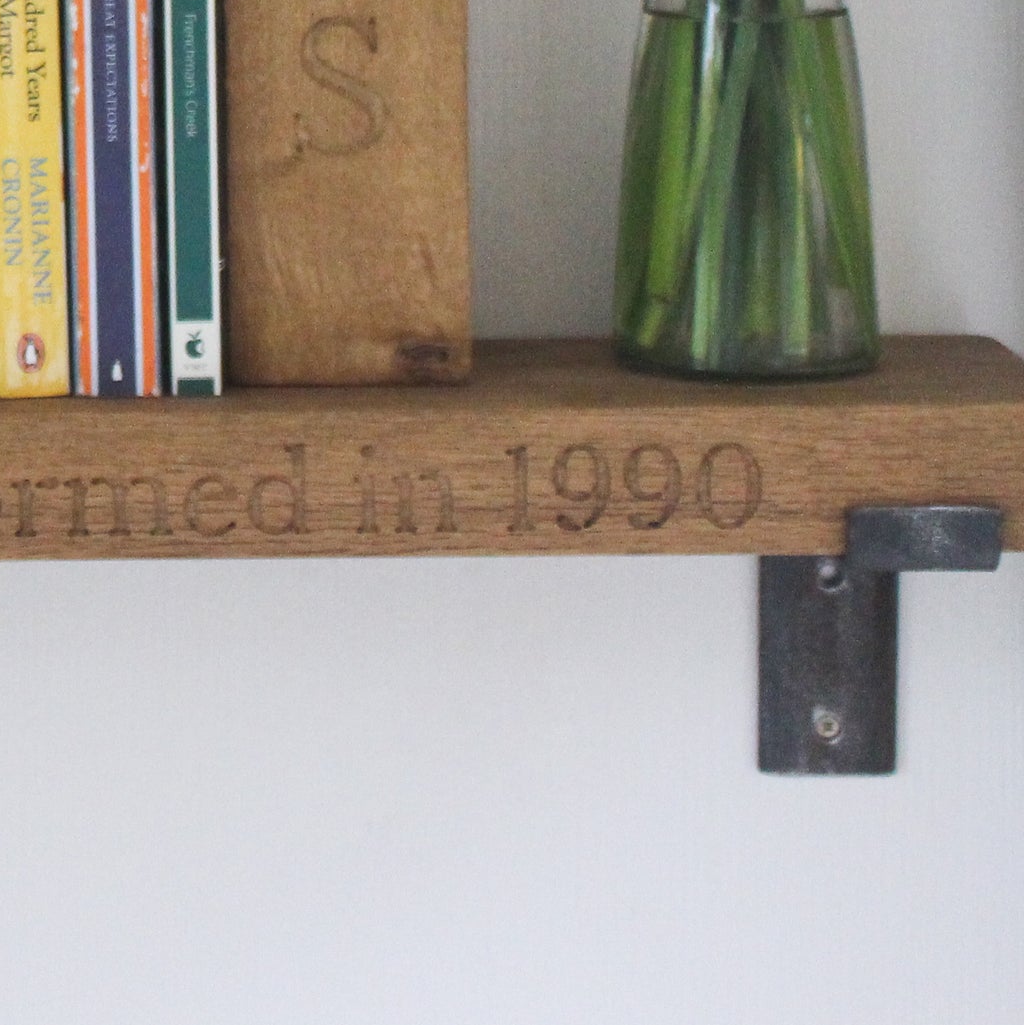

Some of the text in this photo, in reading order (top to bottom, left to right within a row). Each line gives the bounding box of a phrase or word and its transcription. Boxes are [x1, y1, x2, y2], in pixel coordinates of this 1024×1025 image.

[26, 62, 48, 123] Years
[105, 35, 119, 143] EXPECTATIONS
[185, 100, 199, 138] Creek
[294, 15, 394, 157] S
[1, 158, 23, 267] CRONIN
[29, 157, 53, 305] MARIANNE
[353, 443, 459, 535] in
[504, 441, 764, 533] 1990
